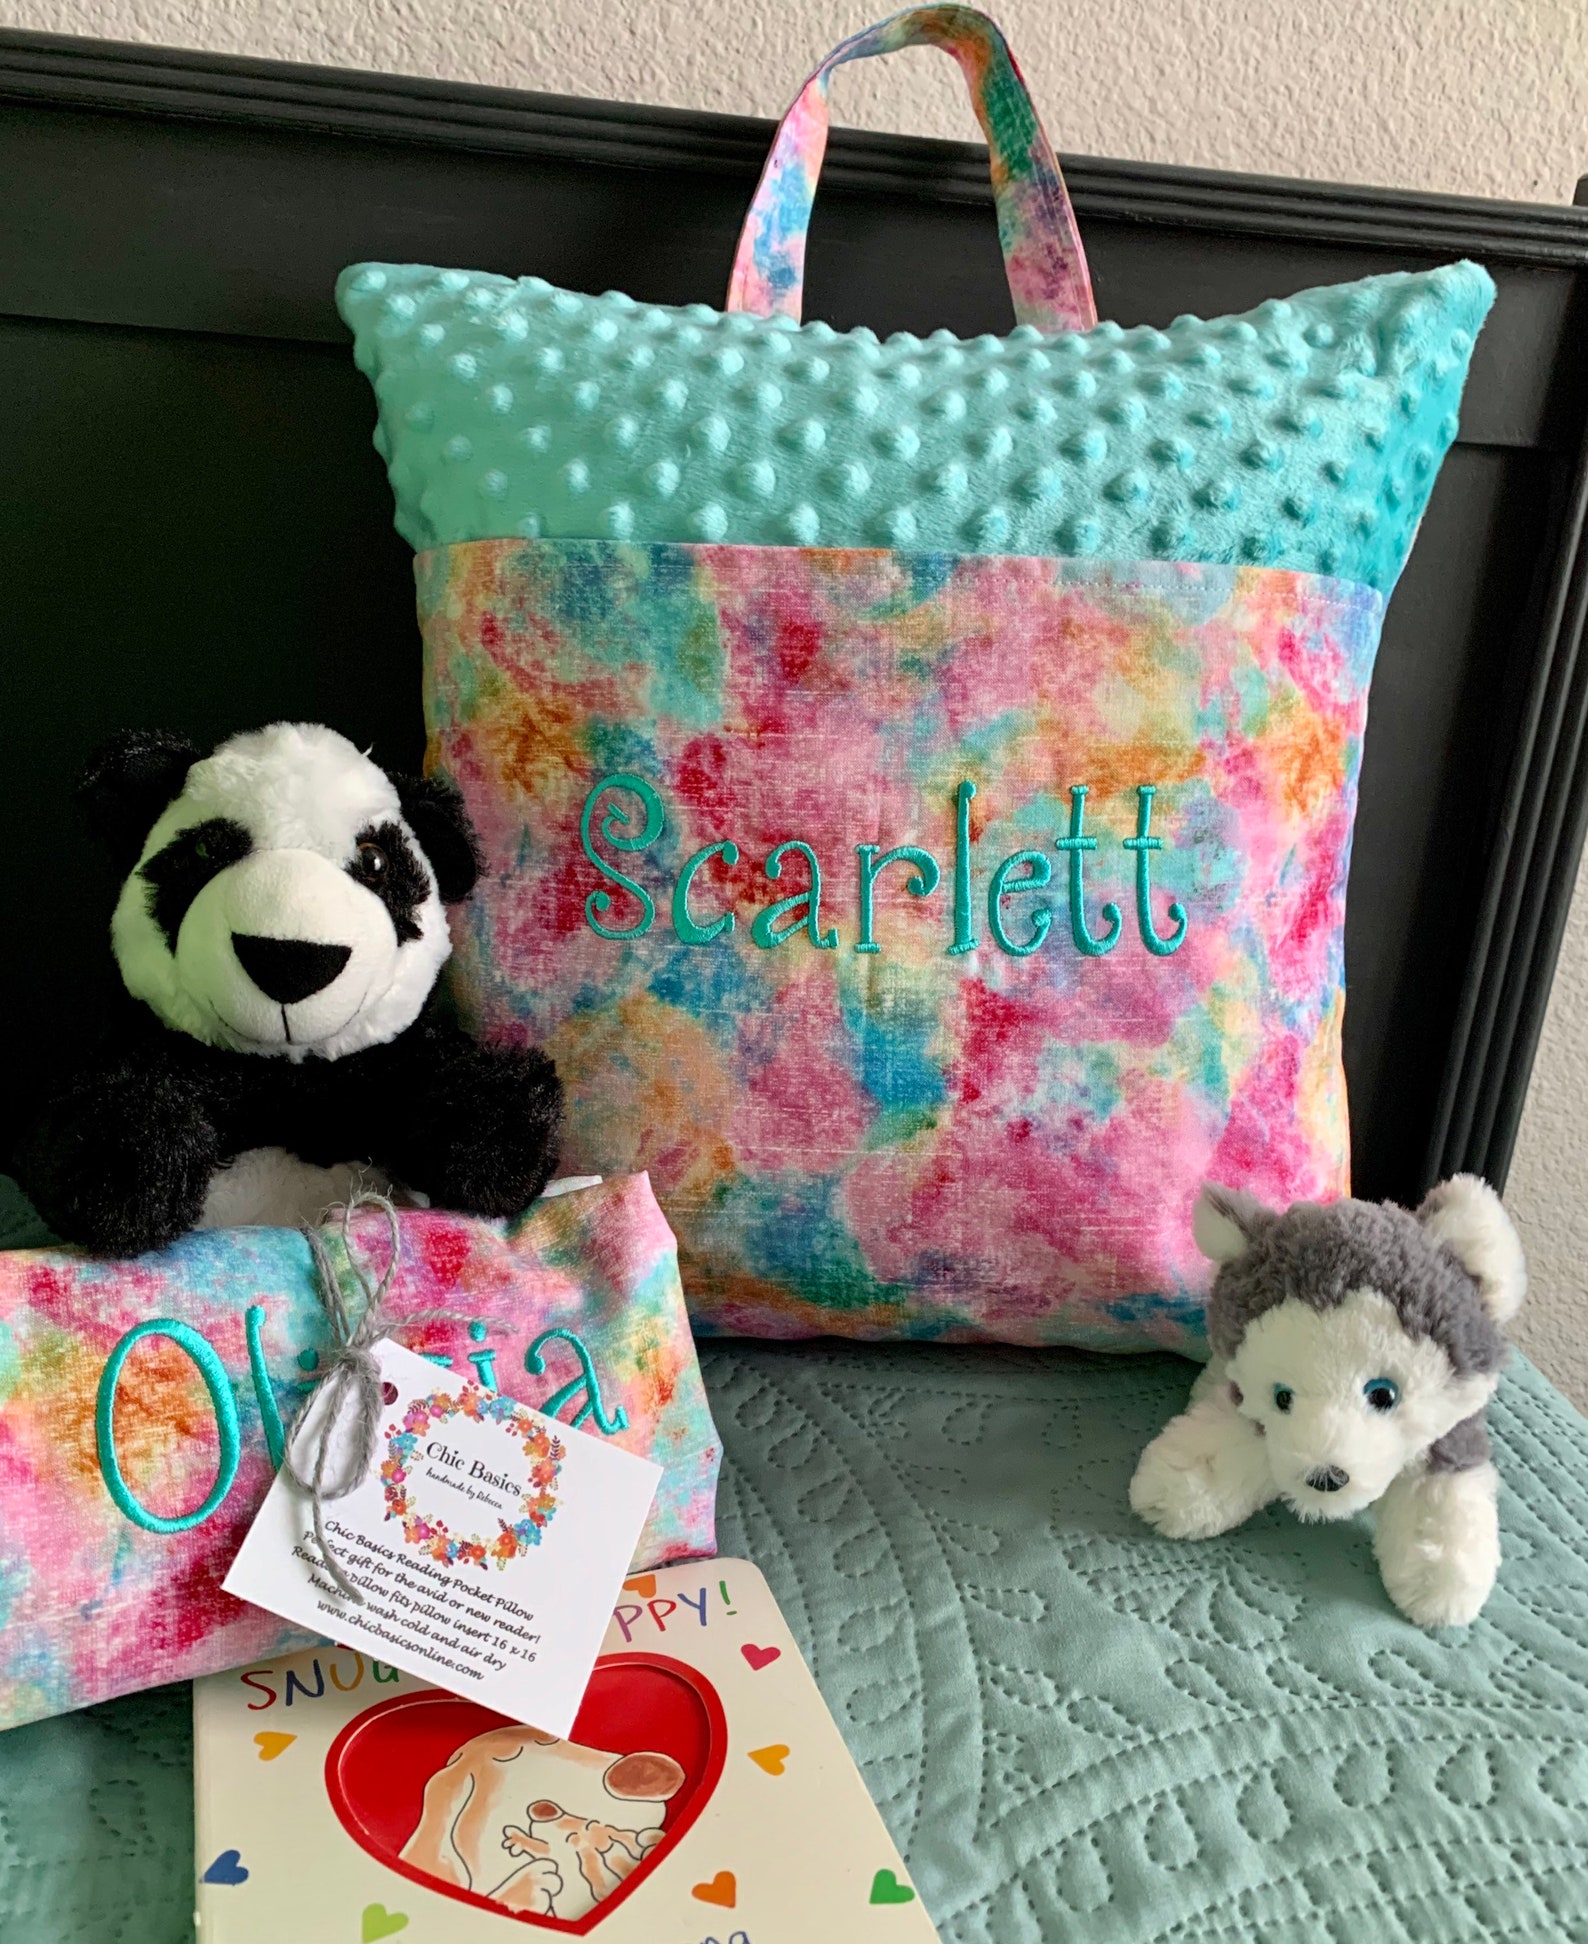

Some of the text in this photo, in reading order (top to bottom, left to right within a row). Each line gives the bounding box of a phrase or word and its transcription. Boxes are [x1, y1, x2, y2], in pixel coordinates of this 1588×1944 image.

[580, 772, 1189, 957] Scarlett
[425, 1467, 502, 1509] handmade by Rebecca
[426, 1441, 522, 1496] Chic Basics
[325, 1520, 534, 1621] Chic Basics Reading Pocket Pillow
[346, 1553, 374, 1569] gift
[371, 1562, 393, 1577] for
[394, 1572, 417, 1589] the
[416, 1585, 449, 1602] avid
[448, 1598, 465, 1610] or
[465, 1607, 491, 1623] new
[493, 1619, 541, 1644] reader!
[317, 1600, 485, 1680] www.chicbasicsonline.com
[366, 1602, 401, 1622] wash
[400, 1619, 431, 1636] cold
[430, 1631, 461, 1649] and
[460, 1644, 483, 1658] air
[483, 1653, 507, 1671] dry
[389, 1591, 413, 1608] fits
[410, 1601, 451, 1625] pillow
[453, 1619, 492, 1642] insert
[491, 1637, 508, 1650] 16
[509, 1645, 521, 1655] x
[520, 1649, 537, 1662] 16
